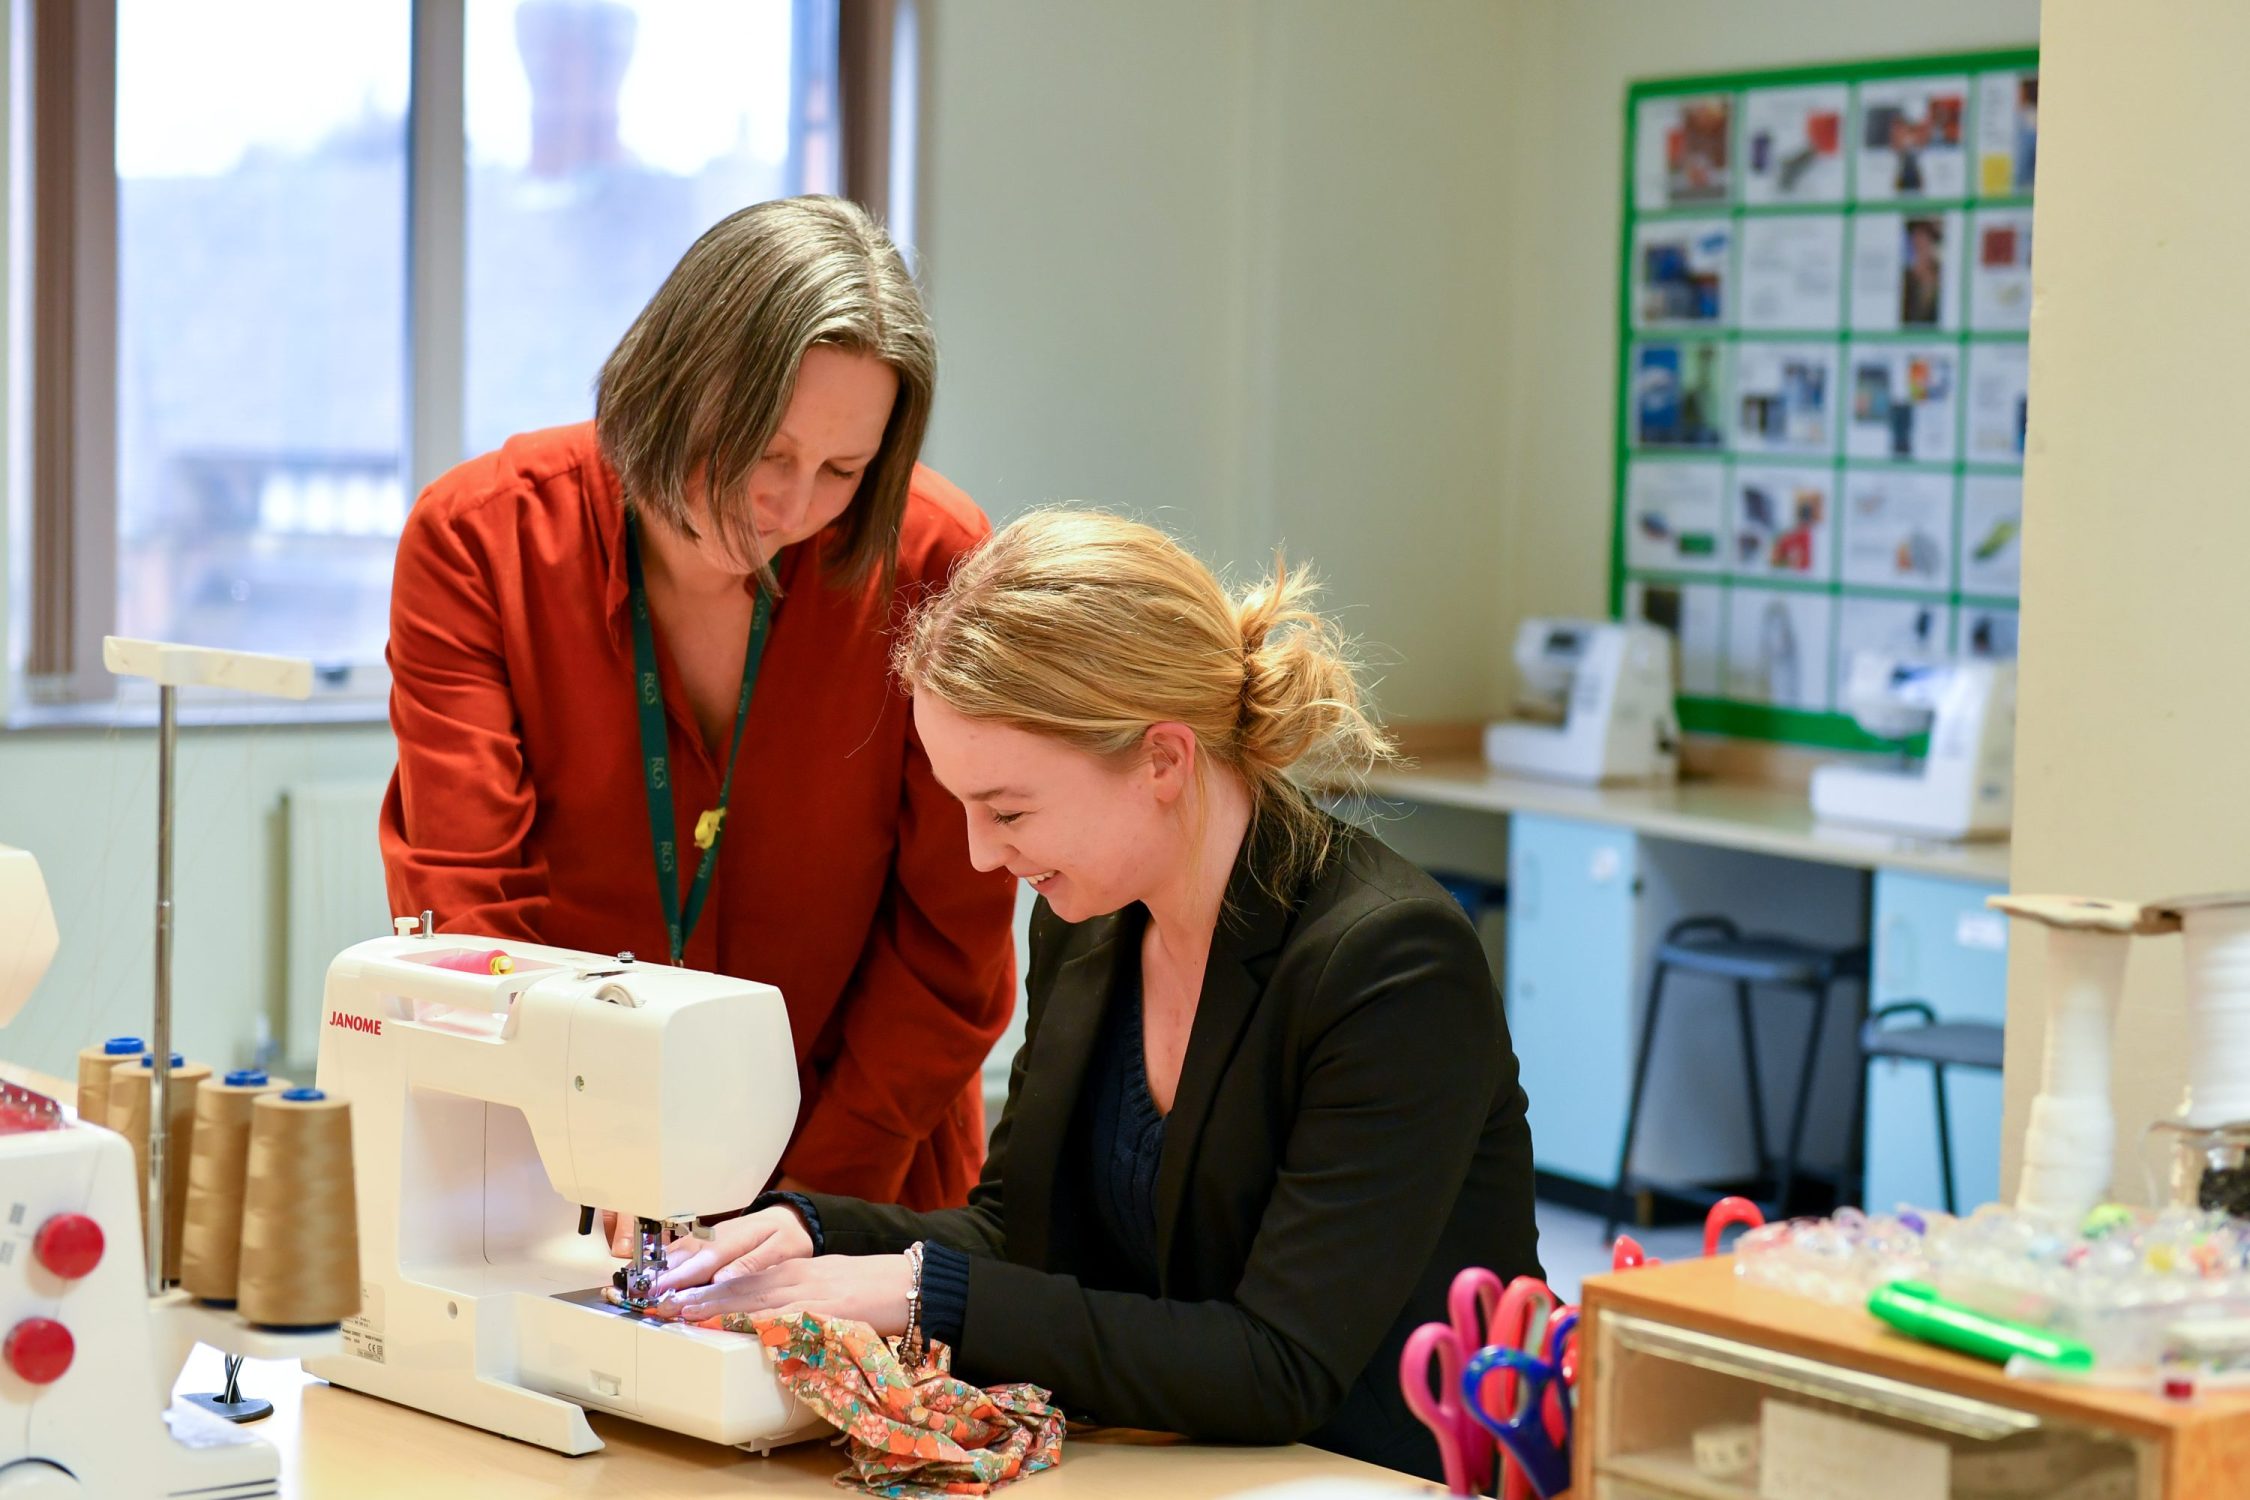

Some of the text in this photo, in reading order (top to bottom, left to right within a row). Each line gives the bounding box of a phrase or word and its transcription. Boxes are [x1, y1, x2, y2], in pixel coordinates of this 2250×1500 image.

[644, 672, 656, 704] RGS
[651, 757, 667, 789] RGS
[660, 841, 673, 873] RGS
[329, 1011, 382, 1036] JANOME
